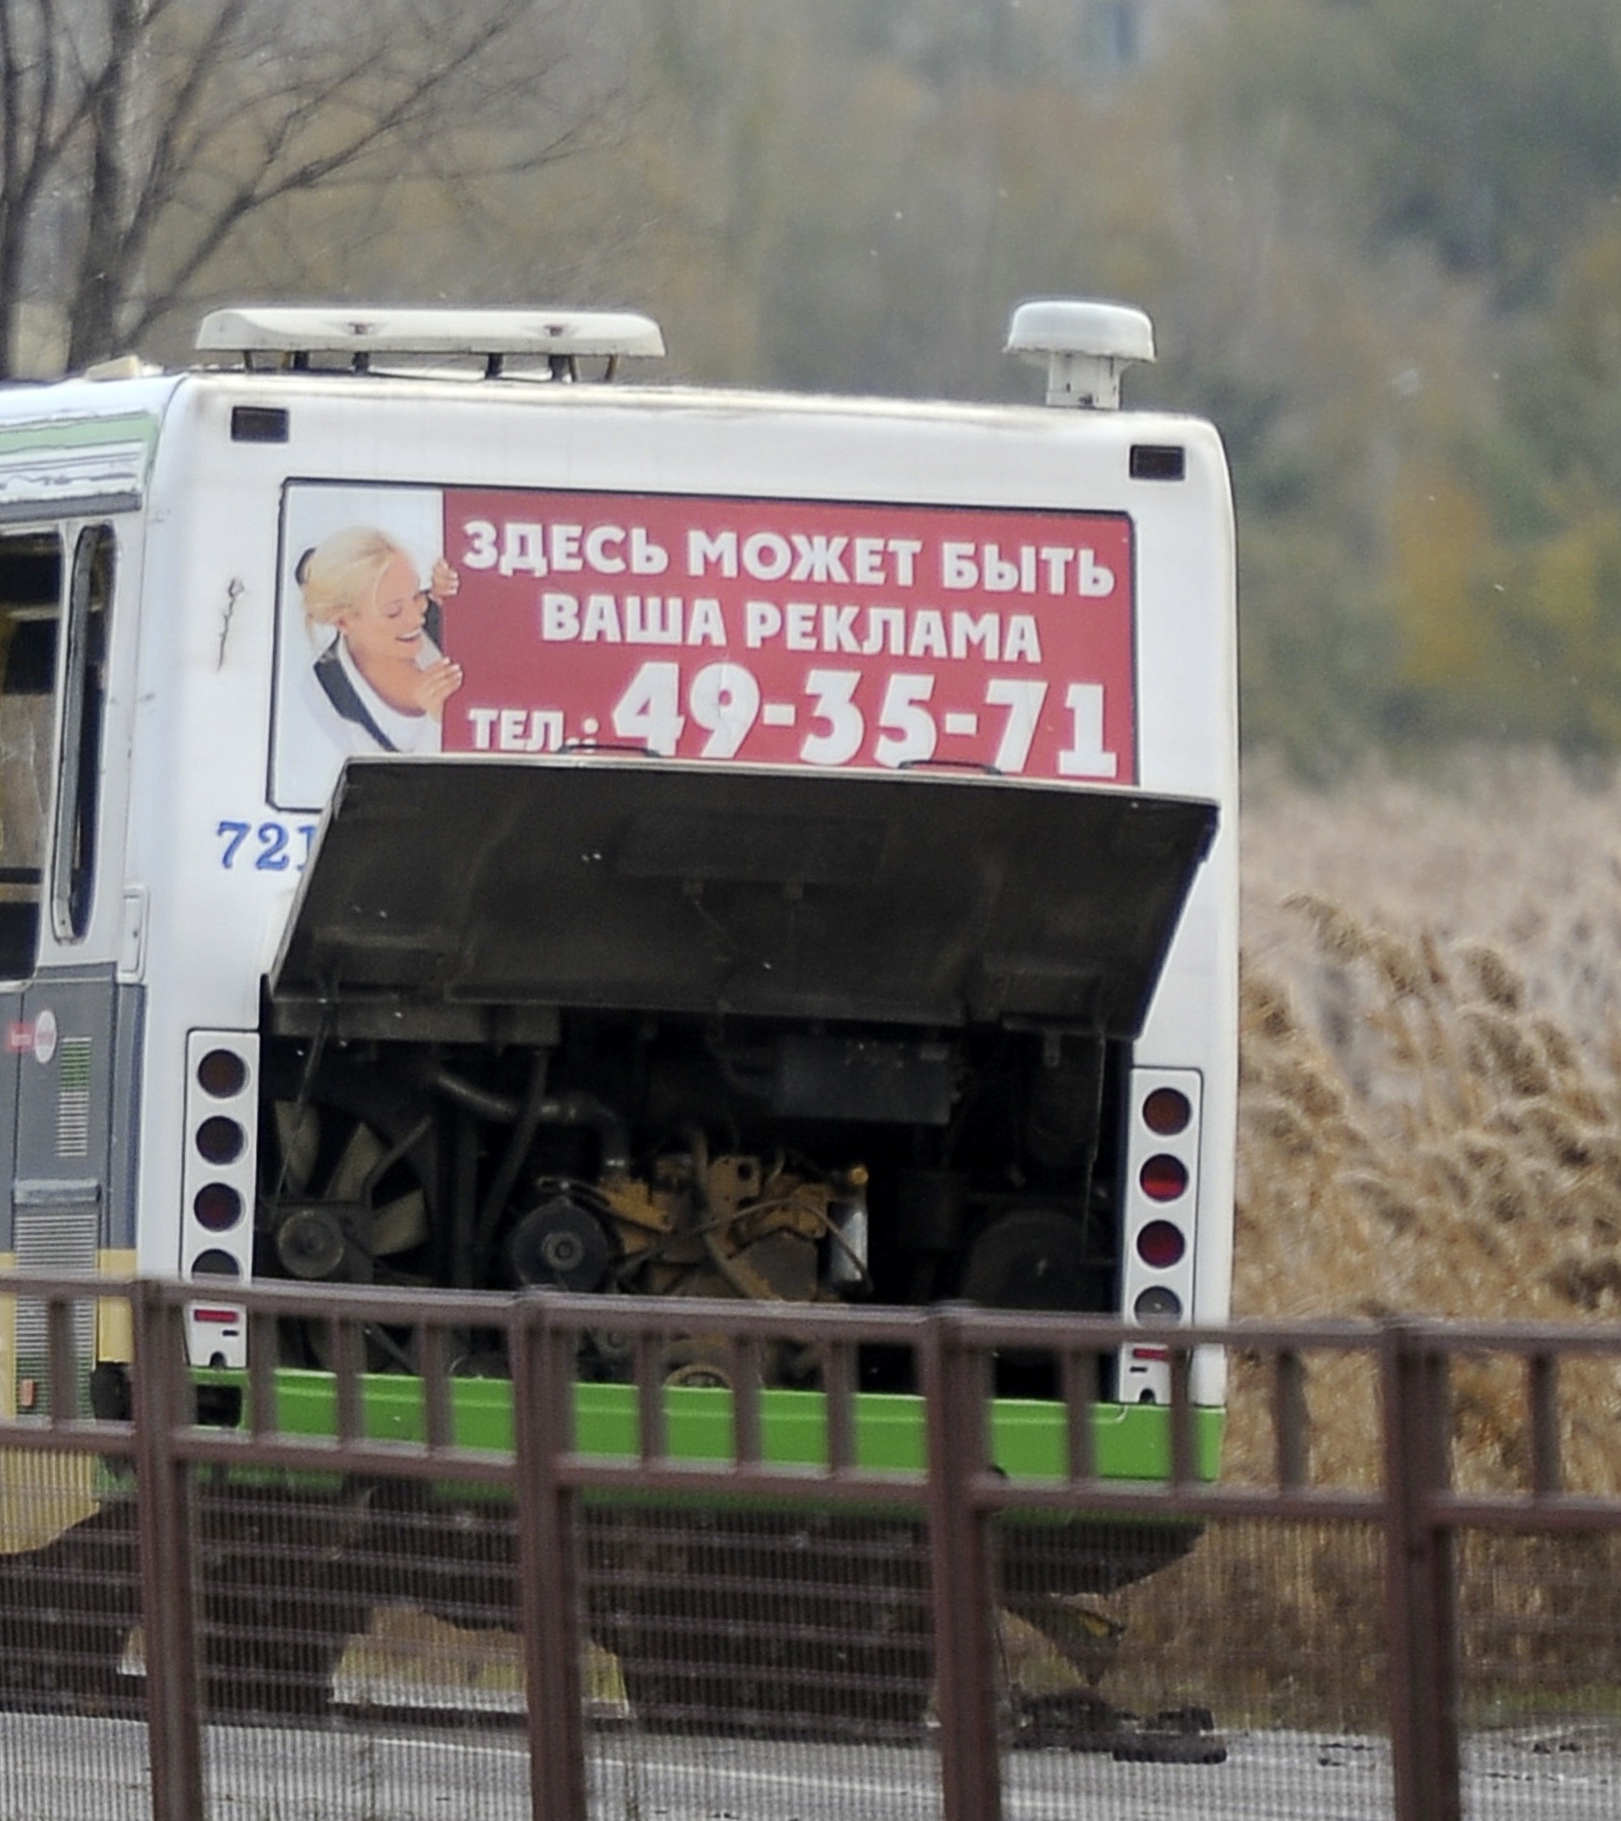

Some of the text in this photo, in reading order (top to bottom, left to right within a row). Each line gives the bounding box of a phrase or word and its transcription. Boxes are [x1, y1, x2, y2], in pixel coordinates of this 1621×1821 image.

[462, 519, 1116, 598] ЗДЕСЬ МОЖЕТ БЫТЬ
[541, 592, 1043, 664] ВАША РЕКЛАМА
[611, 660, 1118, 777] 49-35-71
